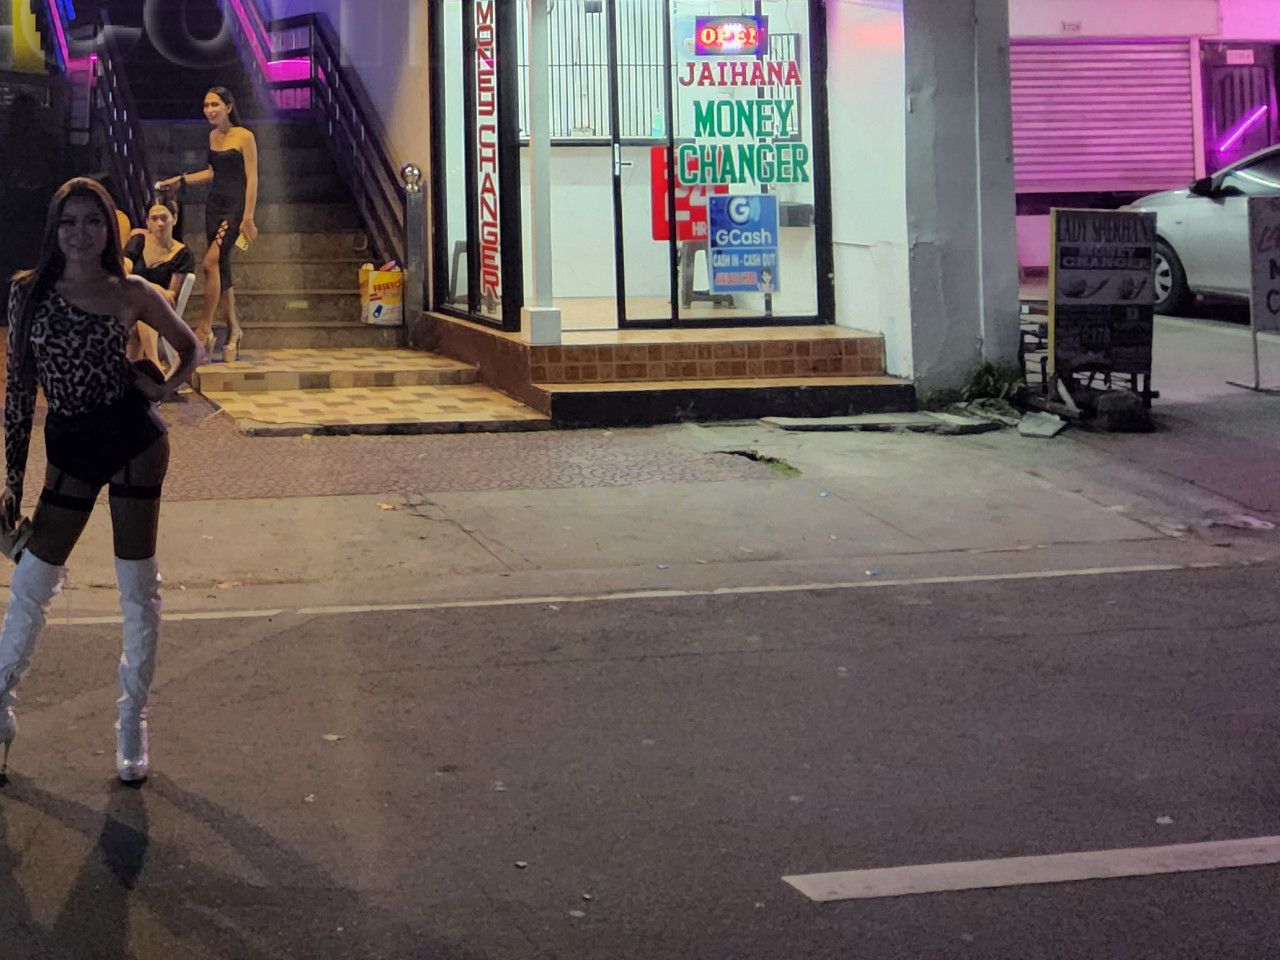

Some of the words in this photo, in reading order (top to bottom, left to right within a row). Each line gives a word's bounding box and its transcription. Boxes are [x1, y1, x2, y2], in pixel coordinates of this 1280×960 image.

[679, 61, 802, 87] JAIHANA
[693, 99, 795, 142] MONEY
[678, 143, 810, 186] CHANGER
[479, 124, 501, 302] CHANGER
[715, 228, 772, 246] GCash
[713, 253, 730, 267] CASH
[731, 253, 739, 267] IN
[743, 253, 761, 267] CASH
